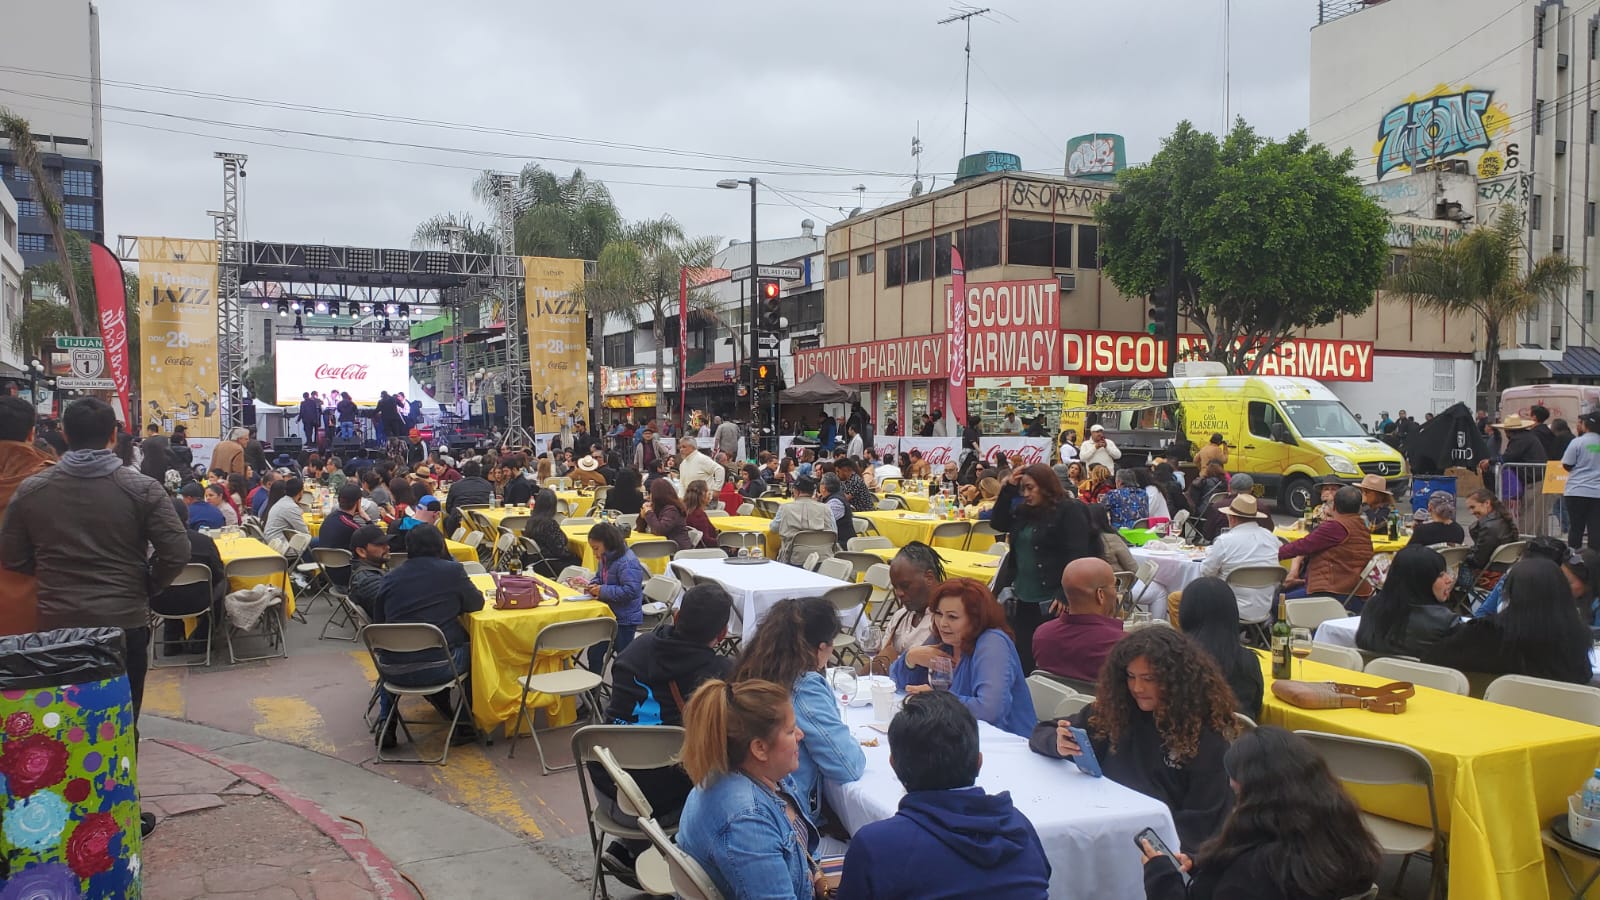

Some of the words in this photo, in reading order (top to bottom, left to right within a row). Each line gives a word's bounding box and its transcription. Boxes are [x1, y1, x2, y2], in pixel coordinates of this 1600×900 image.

[145, 286, 210, 306] JAZZ
[530, 299, 580, 318] JAZZ
[947, 284, 1057, 329] SCOUNT
[63, 338, 104, 348] TIJUAN
[166, 331, 189, 348] 28
[548, 340, 565, 354] 28
[83, 361, 90, 374] 1
[164, 356, 194, 367] Coca-Cola
[797, 347, 857, 384] DISCOUNT
[860, 338, 942, 379] PHARMACY
[315, 363, 370, 380] Coca-Cola
[1190, 420, 1229, 430] PLASENCIA
[1203, 413, 1217, 421] CASA
[909, 446, 952, 465] ca-Cola
